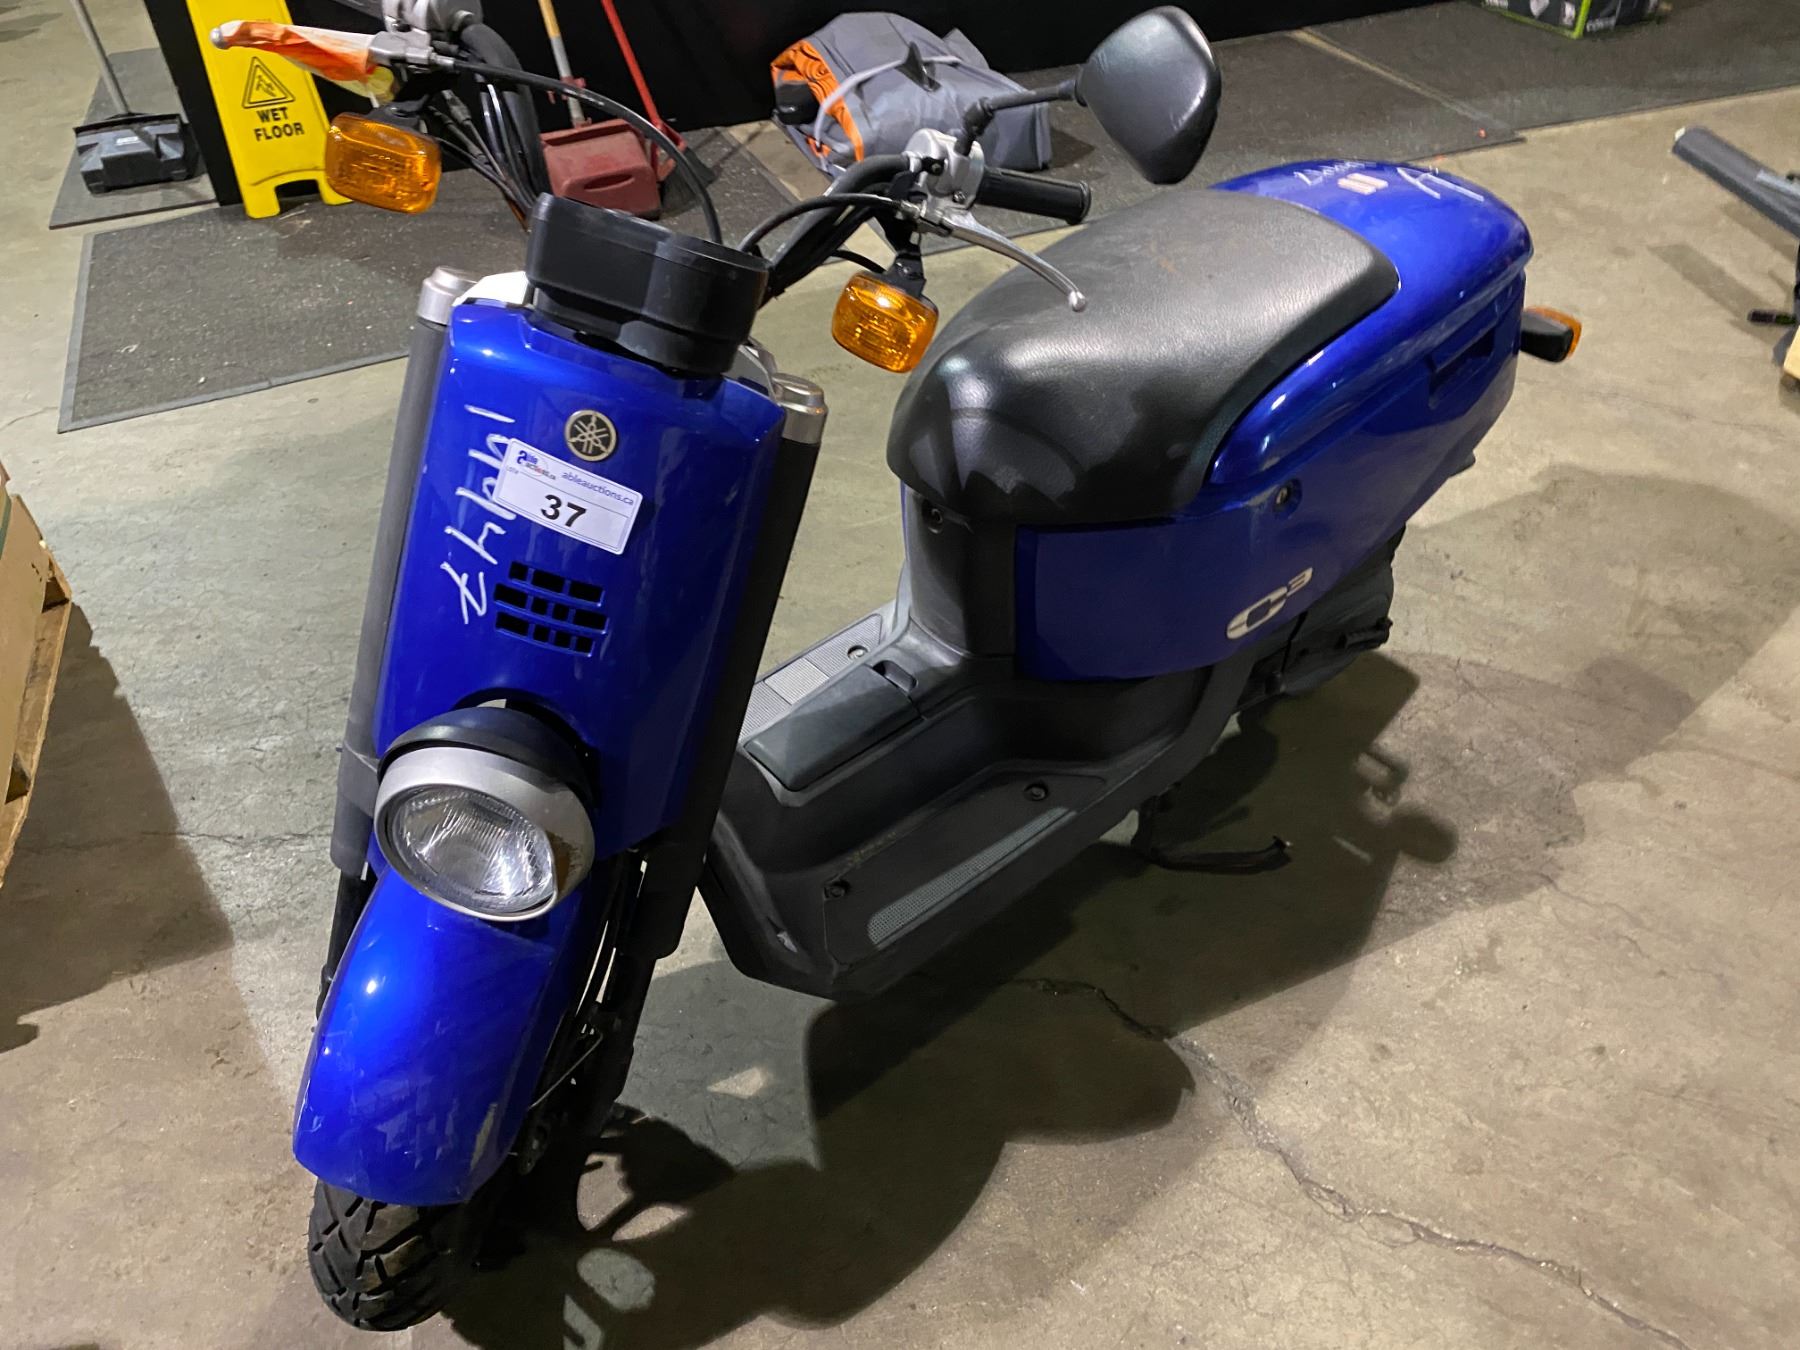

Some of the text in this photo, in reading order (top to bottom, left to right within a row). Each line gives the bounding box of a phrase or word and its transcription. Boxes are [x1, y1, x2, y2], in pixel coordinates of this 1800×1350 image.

[257, 107, 288, 122] WET
[254, 122, 304, 141] FLOOR
[561, 472, 634, 506] ableauctions.ca
[541, 494, 587, 528] 37
